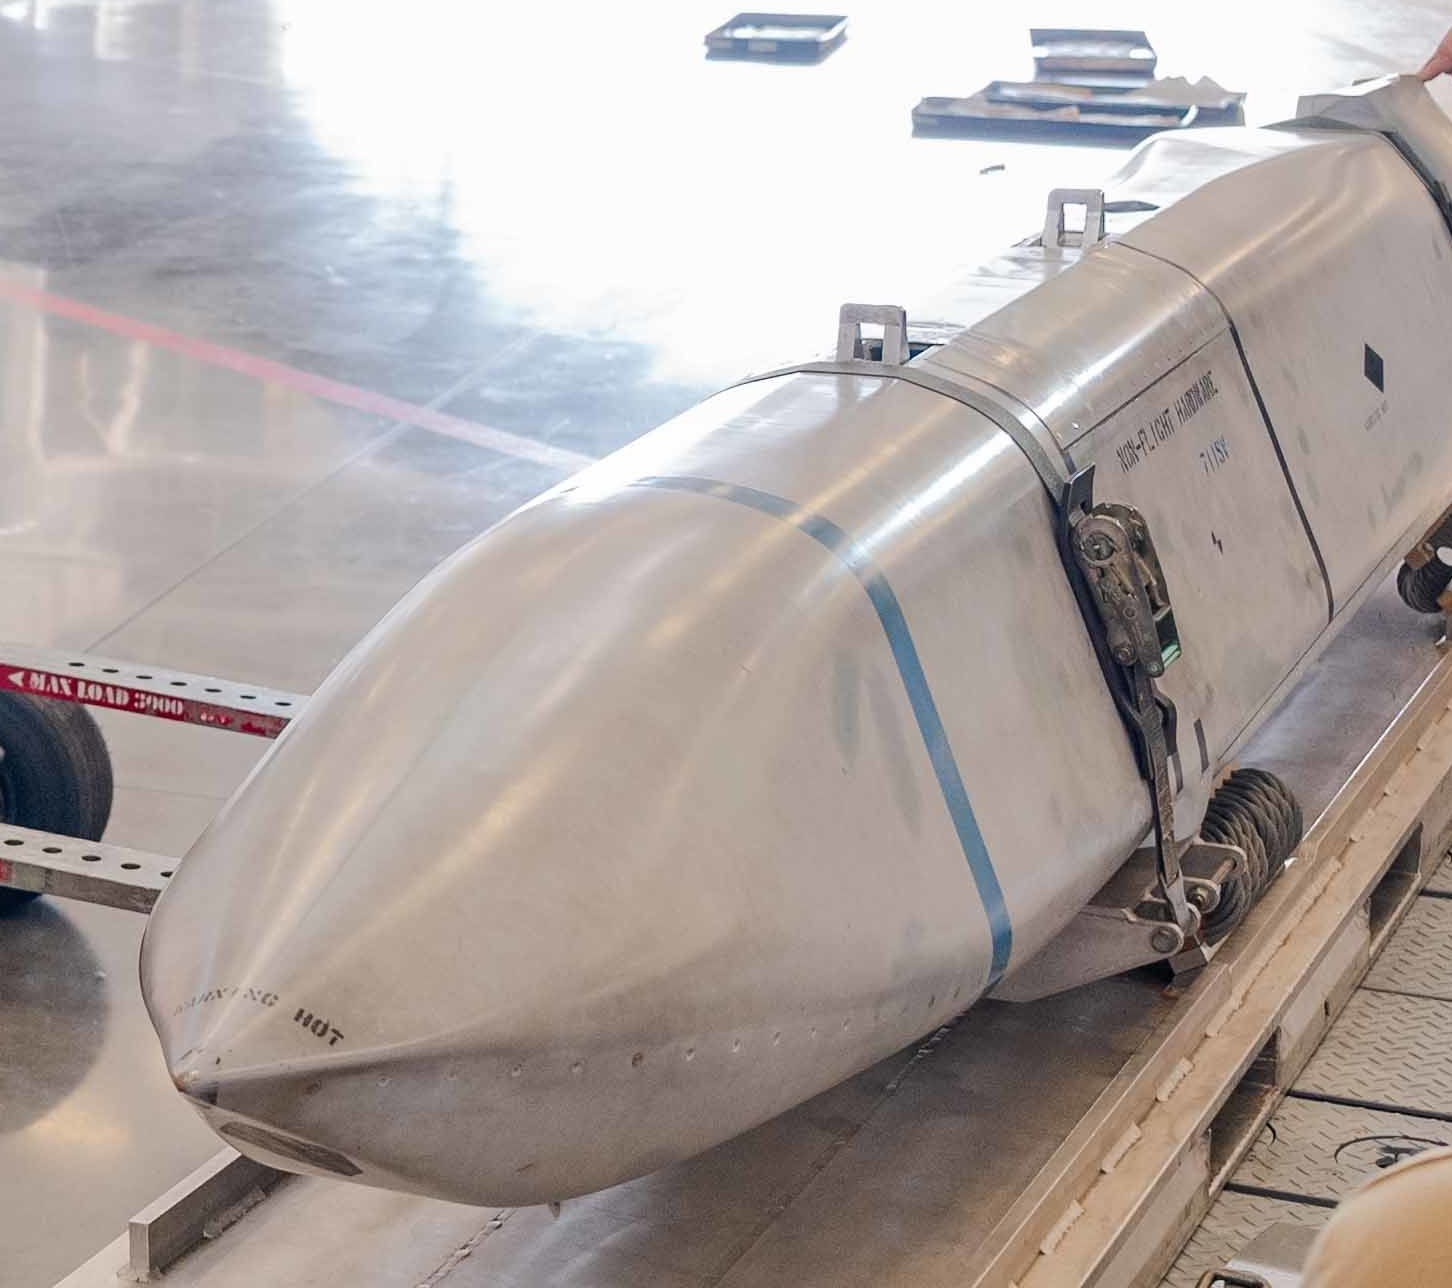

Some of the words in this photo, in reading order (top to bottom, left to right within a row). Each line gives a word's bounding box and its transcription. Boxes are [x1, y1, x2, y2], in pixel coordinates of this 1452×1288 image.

[1116, 406, 1175, 474] NON-FLIGHT
[29, 671, 73, 697] MAX
[76, 680, 130, 707] LOAD
[293, 1007, 345, 1047] HOT
